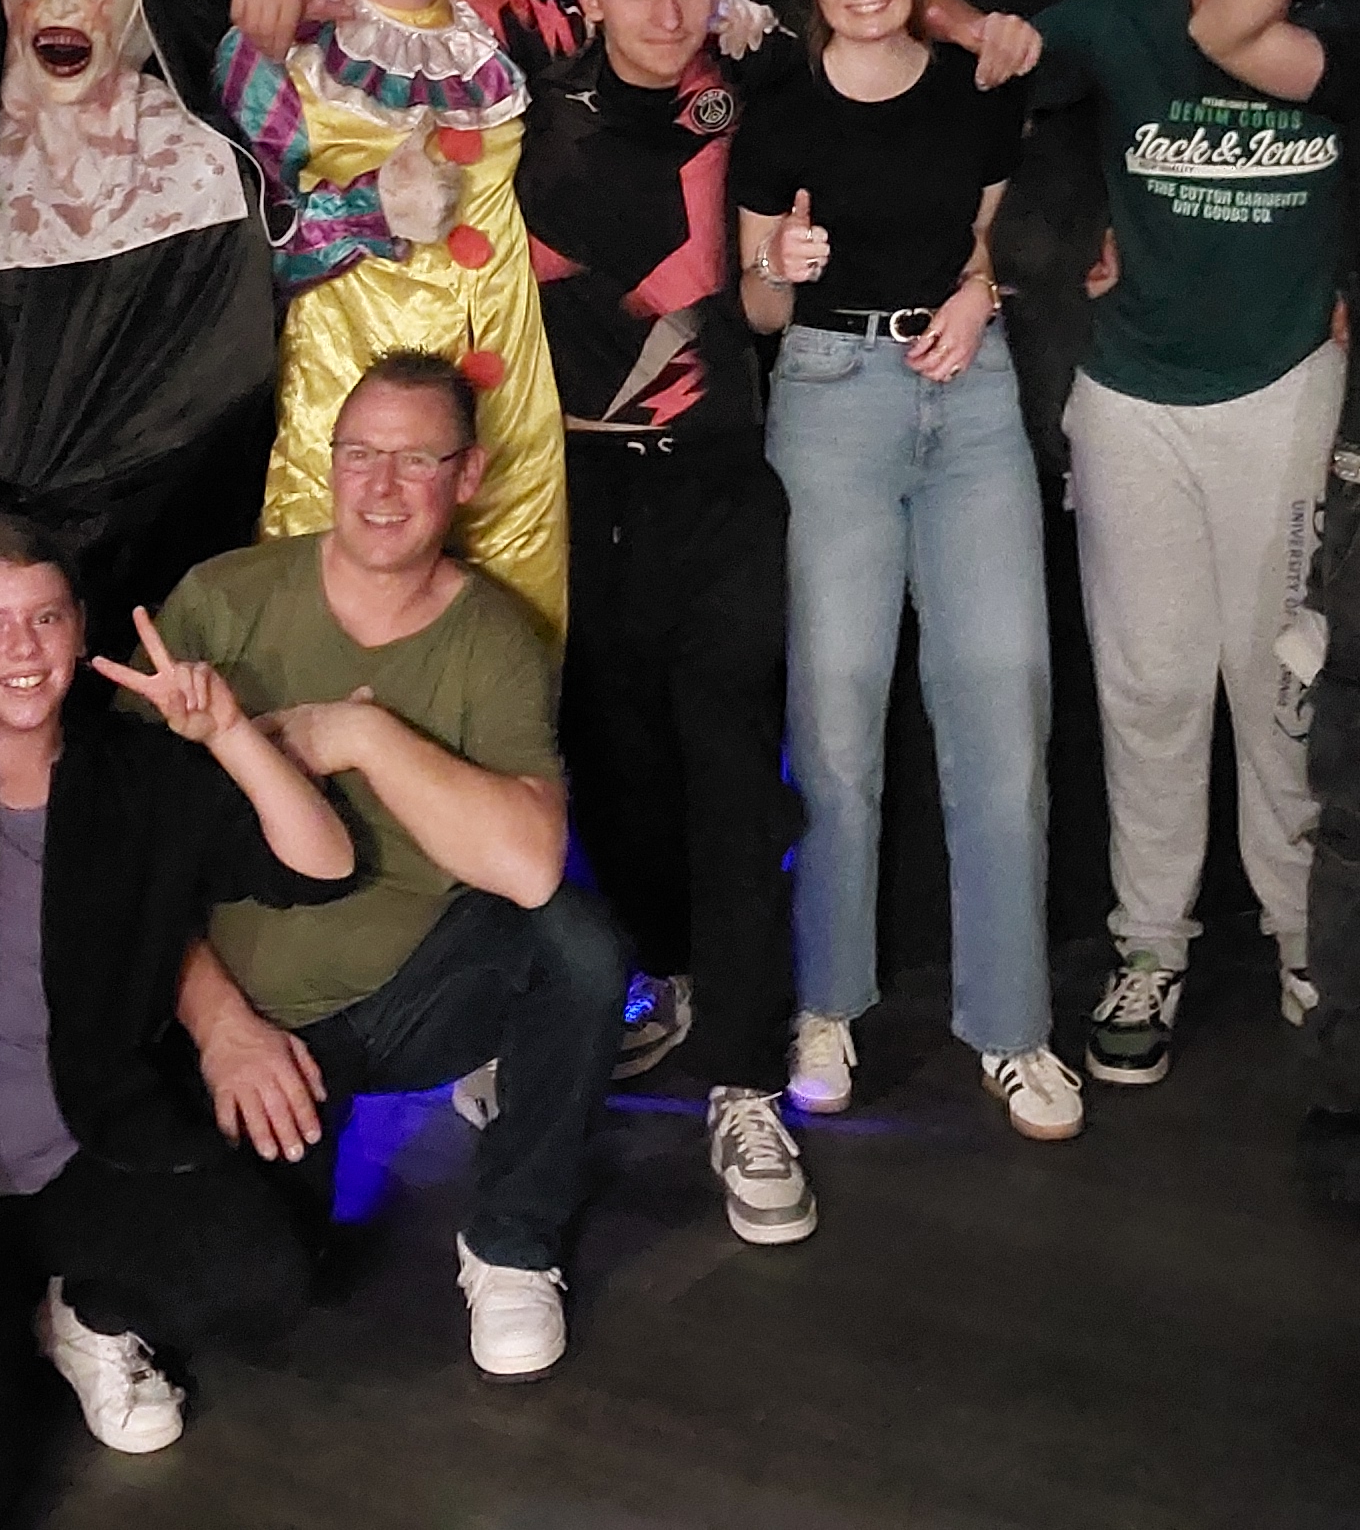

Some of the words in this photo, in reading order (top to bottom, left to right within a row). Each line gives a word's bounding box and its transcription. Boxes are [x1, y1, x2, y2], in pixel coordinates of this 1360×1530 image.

[1169, 100, 1230, 126] DENIM
[1127, 123, 1211, 164] Jack
[1211, 131, 1243, 163] &
[1237, 129, 1339, 170] Jones
